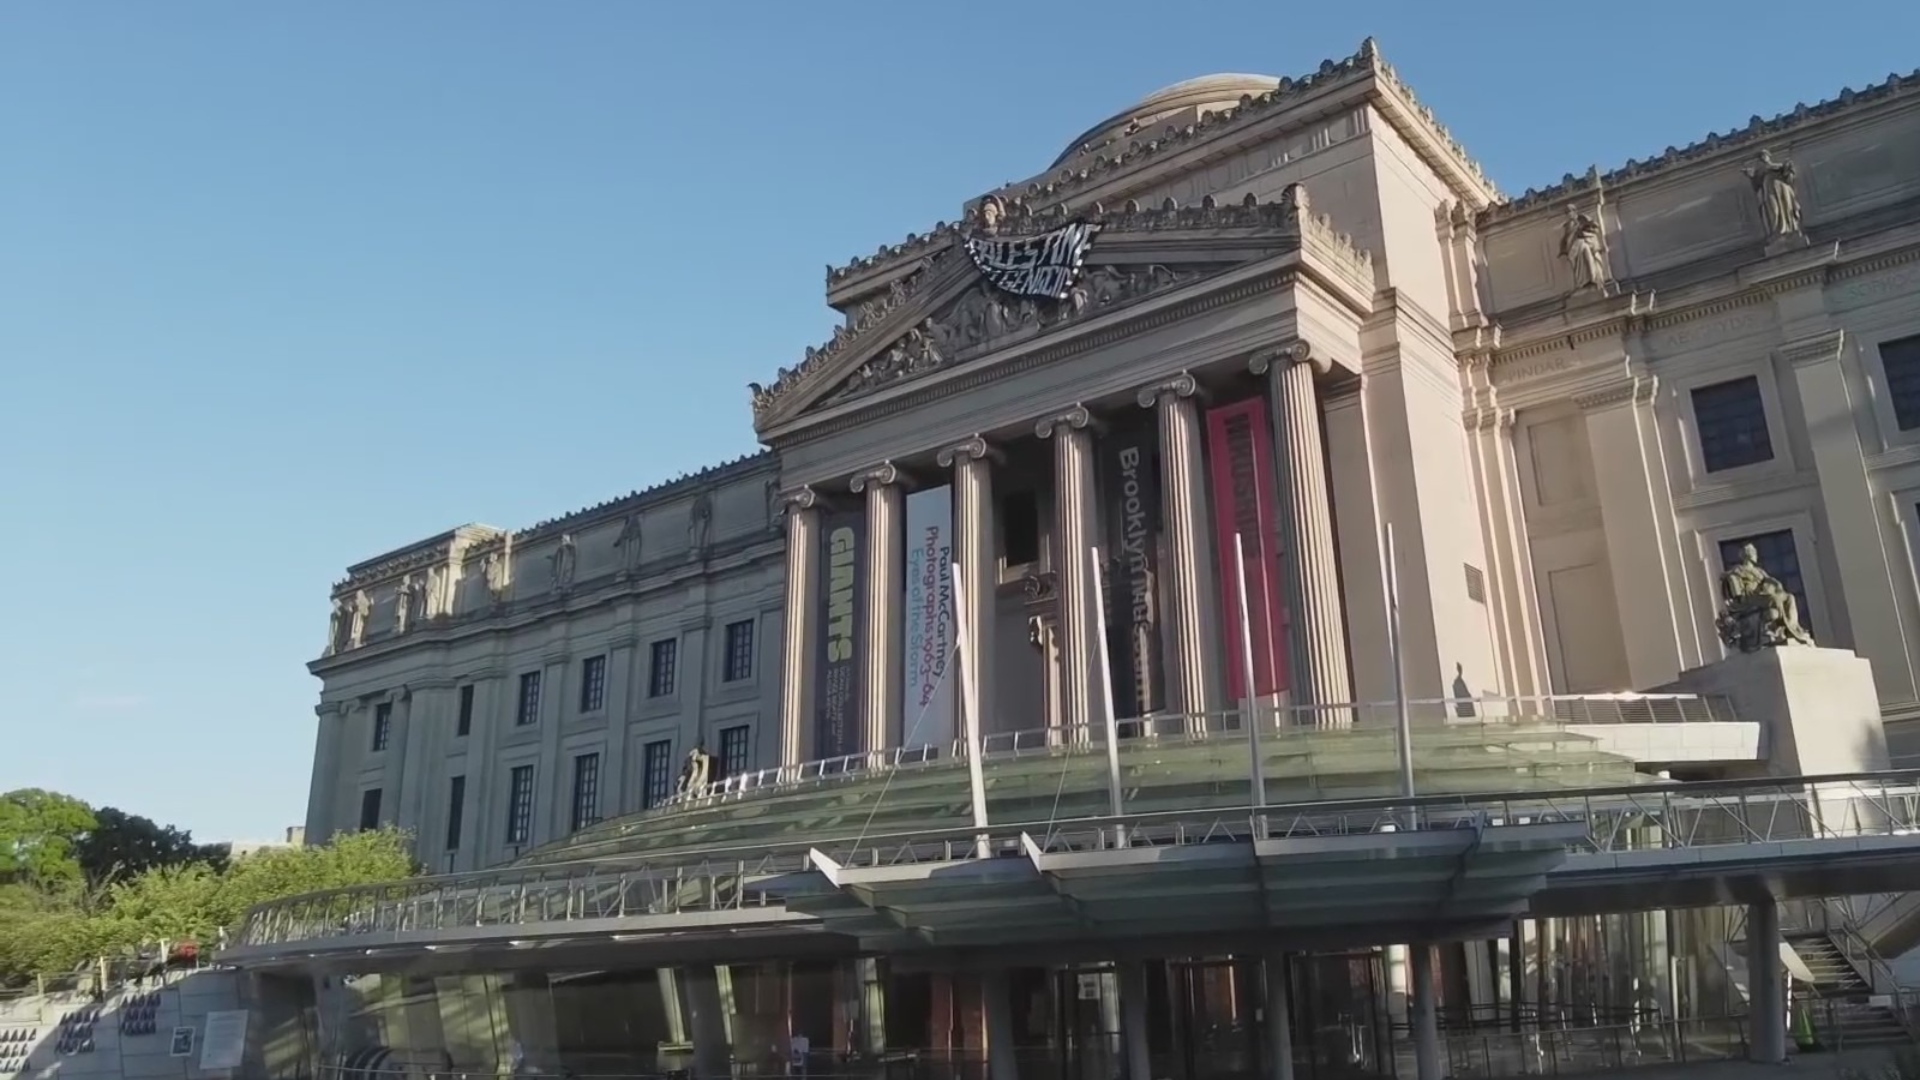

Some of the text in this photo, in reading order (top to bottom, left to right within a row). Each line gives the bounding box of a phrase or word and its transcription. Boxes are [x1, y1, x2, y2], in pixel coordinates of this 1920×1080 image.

[1507, 357, 1567, 382] PINDAR
[1119, 446, 1146, 574] Brooklyn
[827, 527, 855, 663] GIANTS
[909, 548, 924, 586] Eyes
[922, 526, 939, 634] Photographs
[911, 604, 923, 632] the
[932, 546, 950, 679] Paul McCartney
[910, 634, 923, 687] Storm
